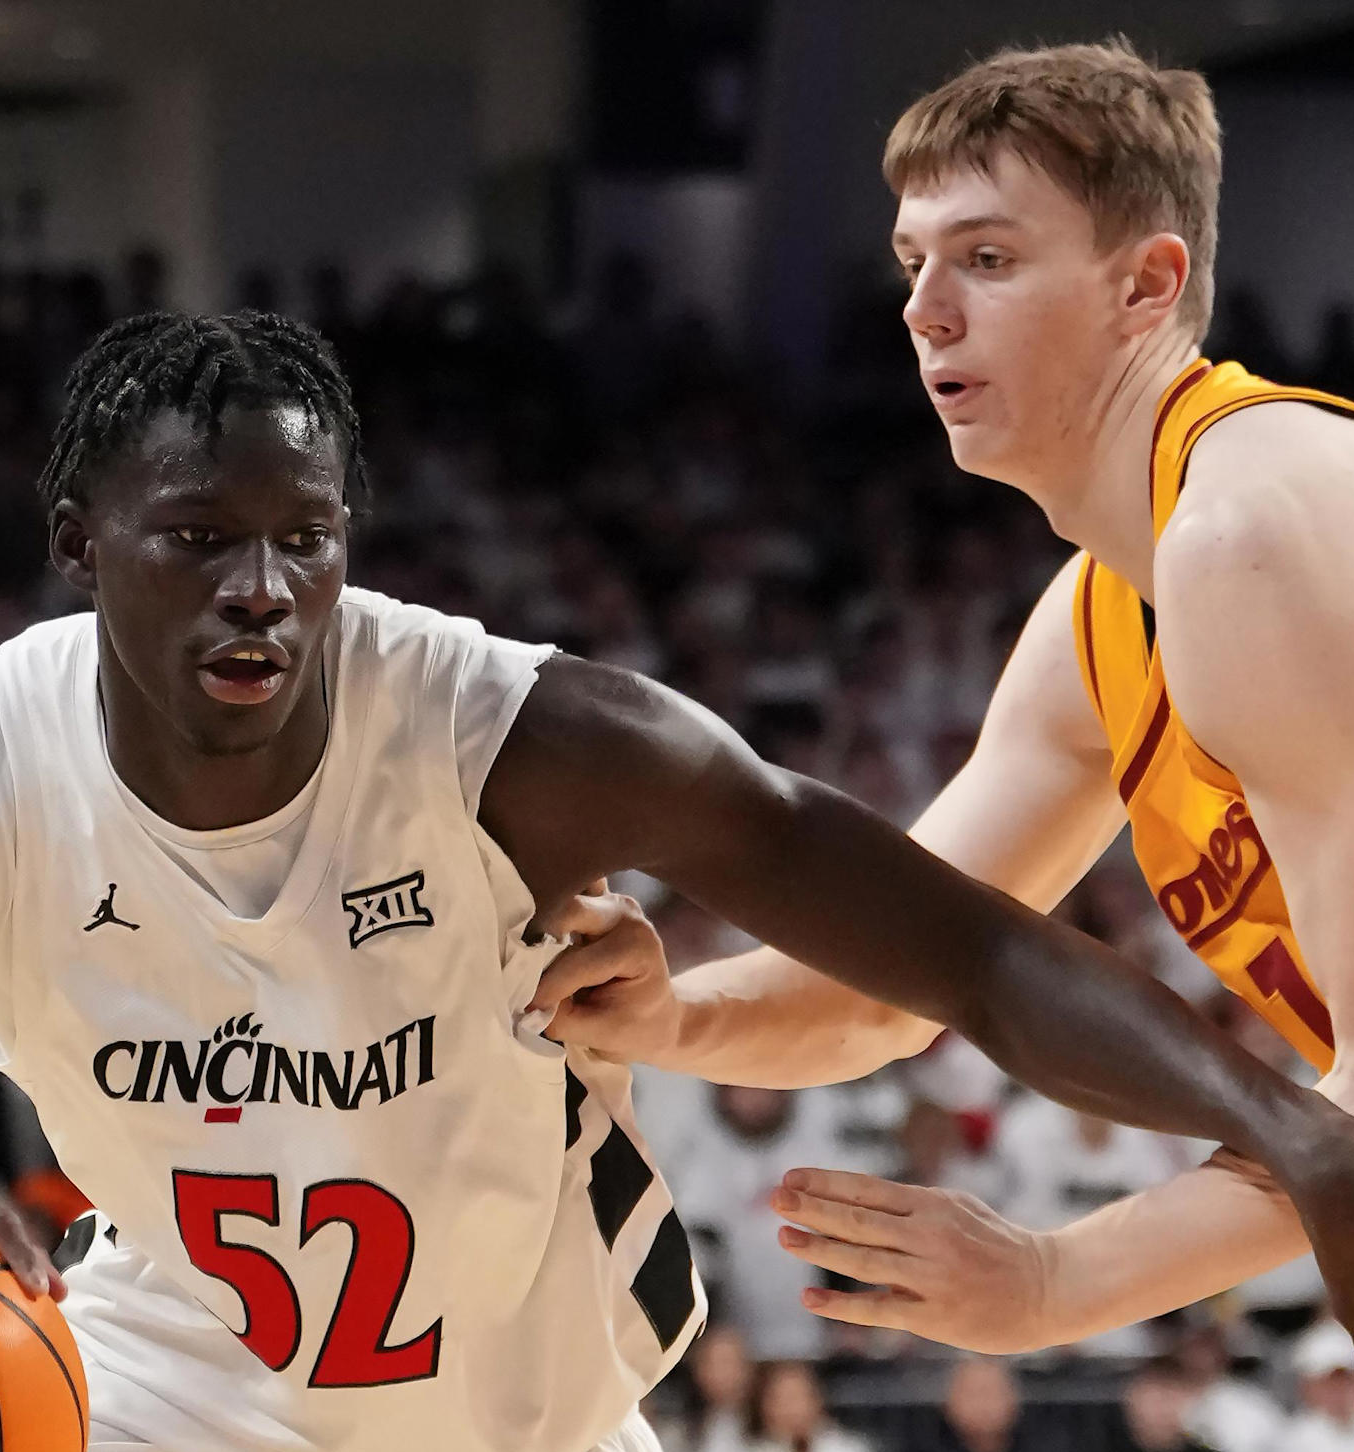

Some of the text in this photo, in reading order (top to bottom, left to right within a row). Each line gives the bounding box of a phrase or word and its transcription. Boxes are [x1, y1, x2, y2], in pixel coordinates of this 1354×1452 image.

[344, 872, 433, 946] XII
[93, 1014, 436, 1111] CINCINNATI
[172, 1168, 443, 1388] 52
